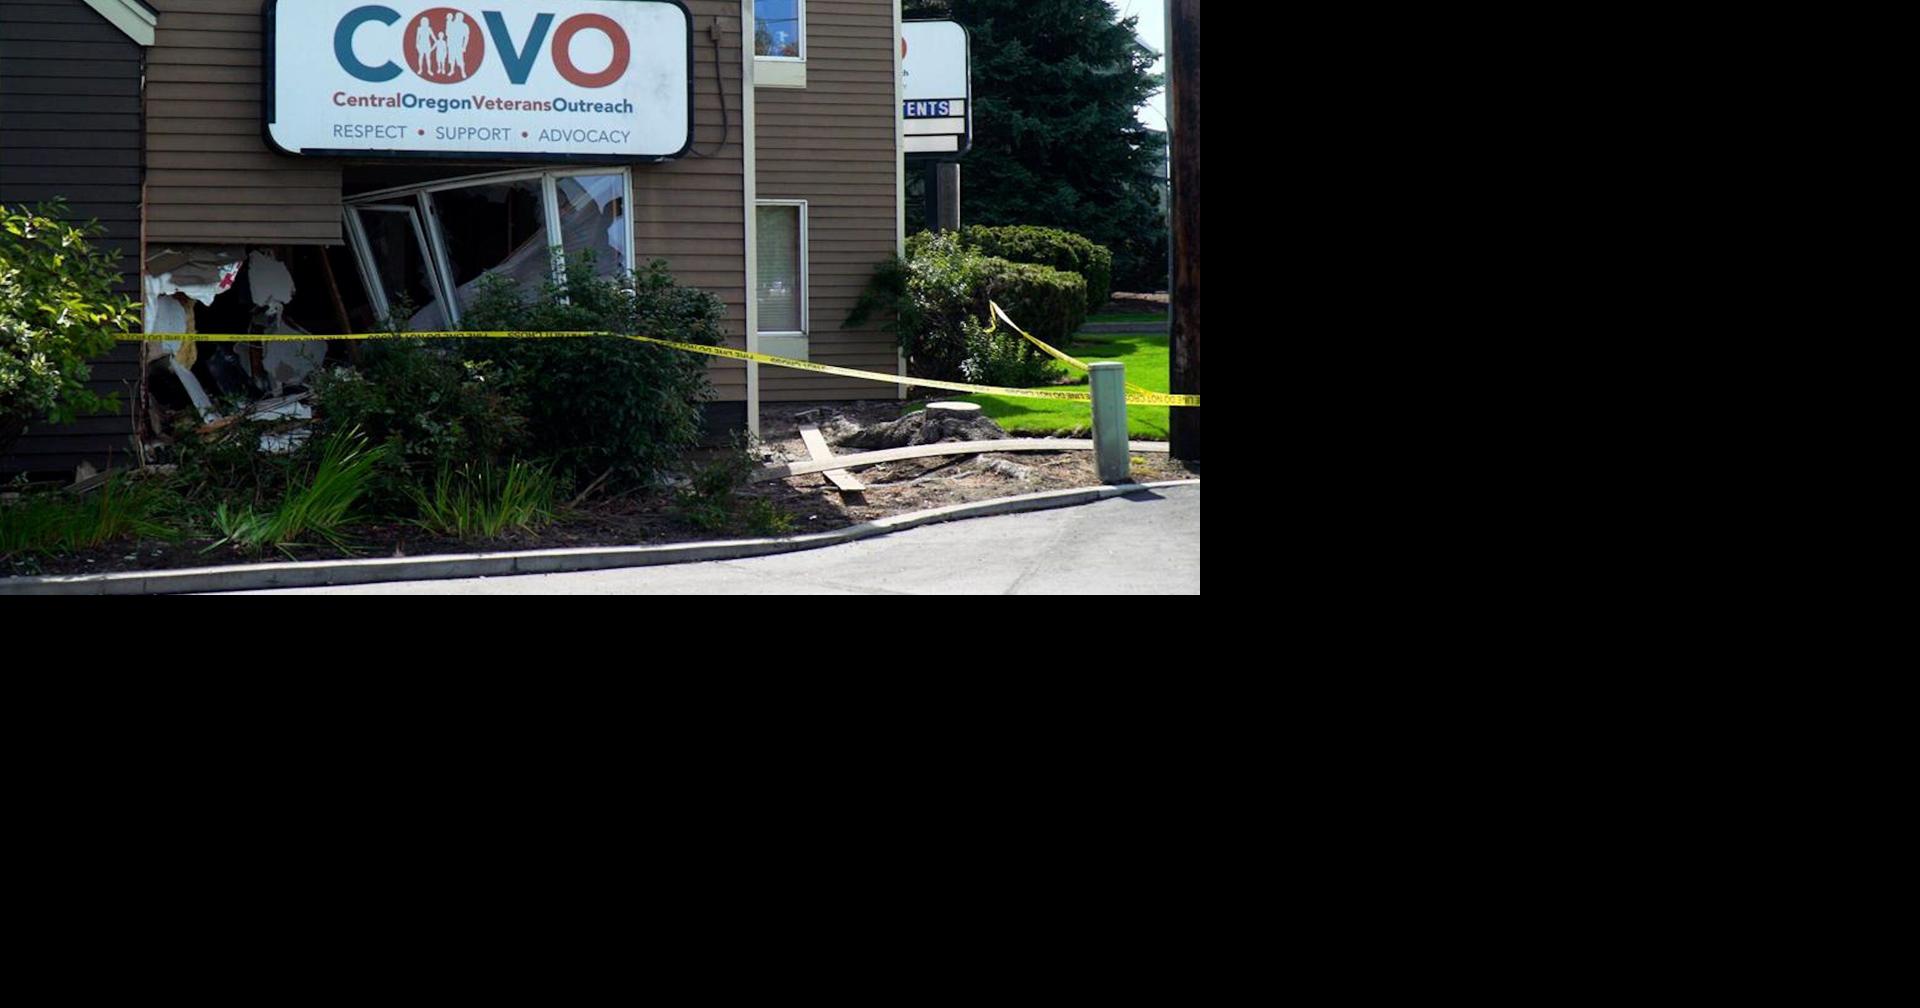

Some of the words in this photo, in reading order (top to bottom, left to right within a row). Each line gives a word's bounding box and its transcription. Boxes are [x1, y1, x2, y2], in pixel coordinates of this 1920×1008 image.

[334, 5, 630, 88] COVO
[334, 124, 407, 139] RESPECT
[436, 126, 511, 141] SUPPORT
[538, 128, 630, 144] ADVOCACY
